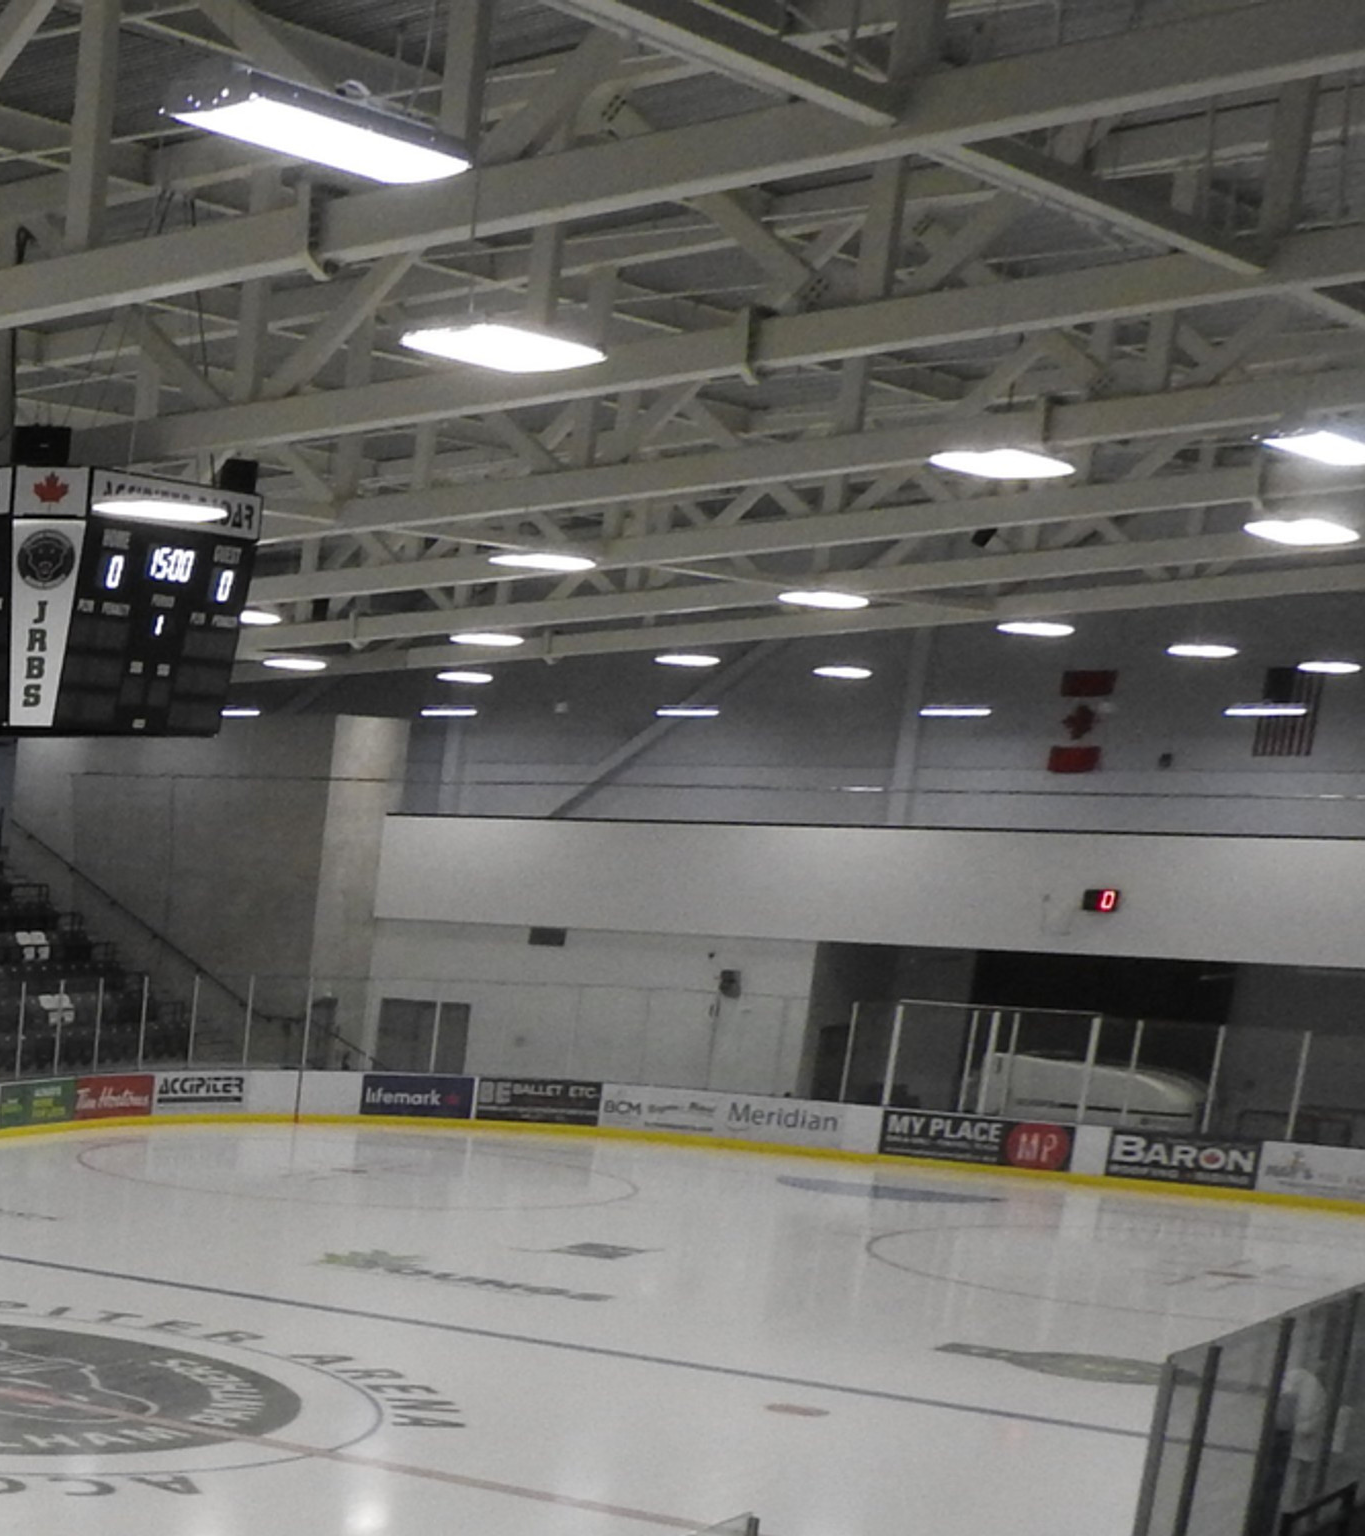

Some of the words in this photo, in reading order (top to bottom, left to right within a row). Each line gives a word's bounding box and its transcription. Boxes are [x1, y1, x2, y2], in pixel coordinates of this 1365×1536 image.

[105, 555, 124, 589] 0
[150, 547, 195, 583] 15:00
[216, 570, 234, 602] 0
[159, 1077, 245, 1095] ACCIPITER
[366, 1087, 442, 1107] lifemark
[513, 1082, 563, 1097] BALLET
[604, 1099, 642, 1116] BCM
[728, 1102, 839, 1132] Meridian
[887, 1114, 927, 1136] MY
[929, 1117, 1003, 1142] PLACE
[1016, 1132, 1059, 1163] MP
